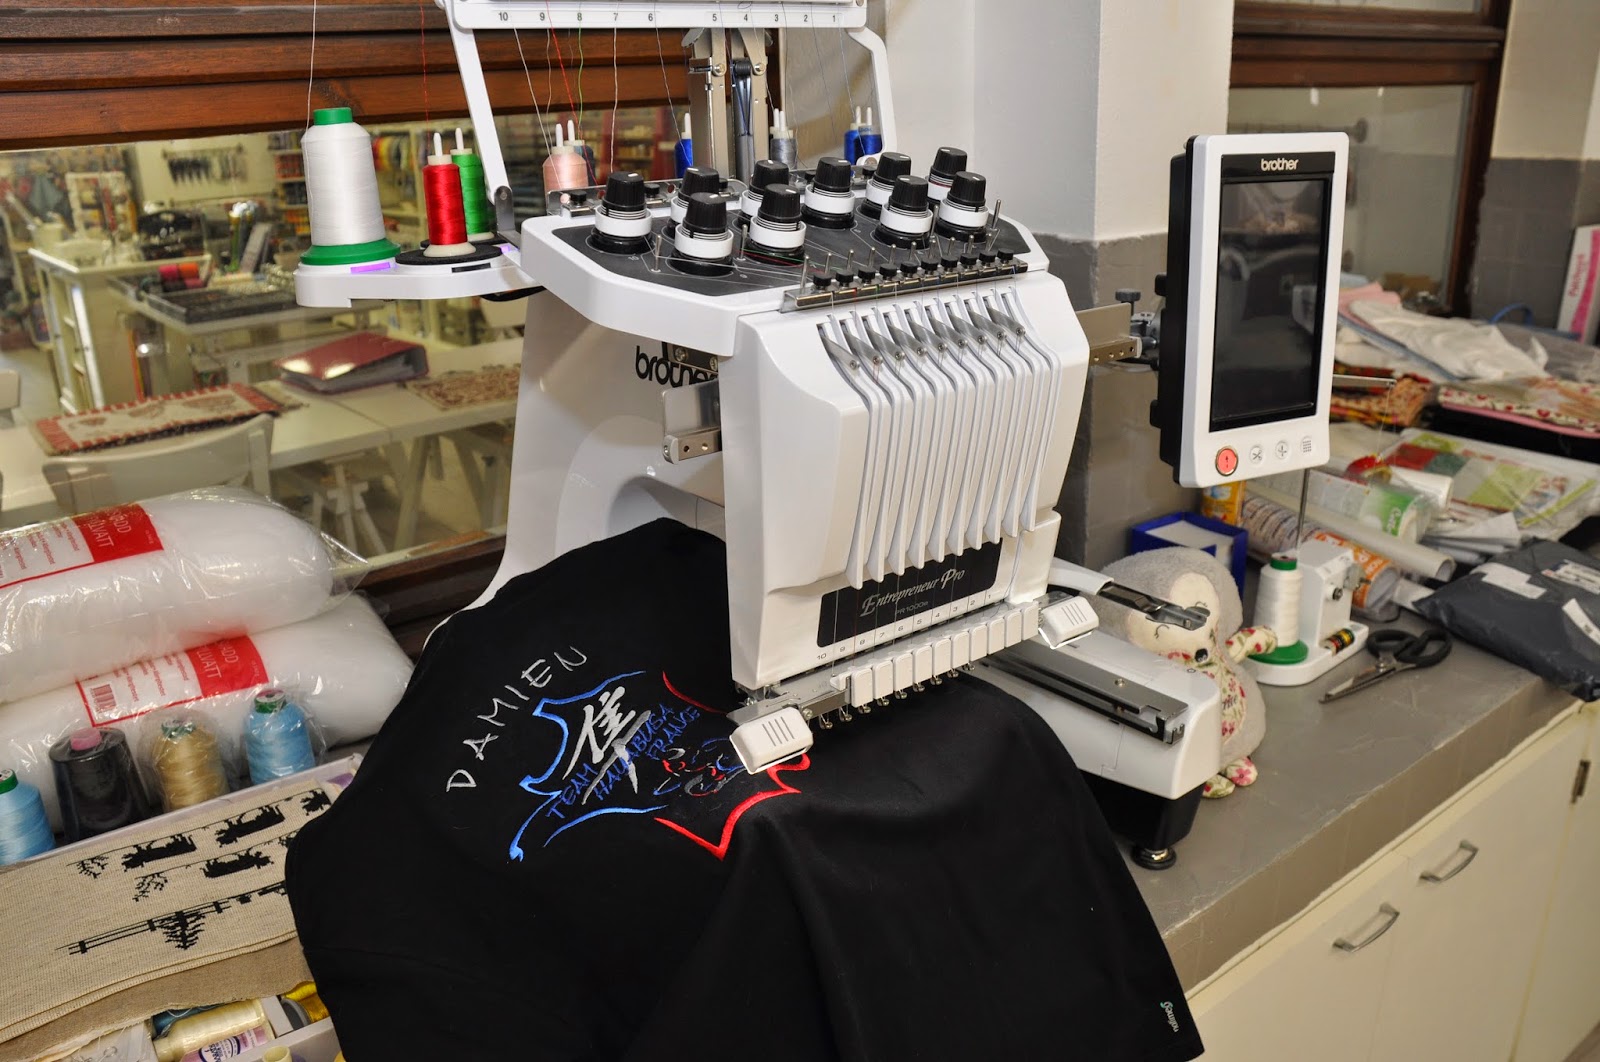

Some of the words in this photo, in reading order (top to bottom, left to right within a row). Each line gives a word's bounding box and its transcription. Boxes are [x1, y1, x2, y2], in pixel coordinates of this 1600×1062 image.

[498, 12, 508, 21] 10
[539, 12, 545, 21] 9
[577, 12, 583, 21] 8
[613, 12, 619, 21] 7
[647, 13, 653, 21] 6
[712, 13, 717, 21] 5
[743, 13, 748, 21] 4
[774, 14, 779, 22] 3
[803, 14, 808, 22] 2
[832, 14, 836, 22] 1
[1260, 157, 1299, 171] brother
[635, 344, 719, 388] broth
[860, 578, 940, 617] Entrepreneur
[940, 568, 966, 590] Pro
[816, 652, 827, 660] 10
[952, 605, 958, 613] 3
[446, 646, 587, 793] DAMIEN
[645, 705, 700, 761] FRANCE
[593, 703, 675, 801] HAYABUSA
[545, 762, 598, 819] TEAM
